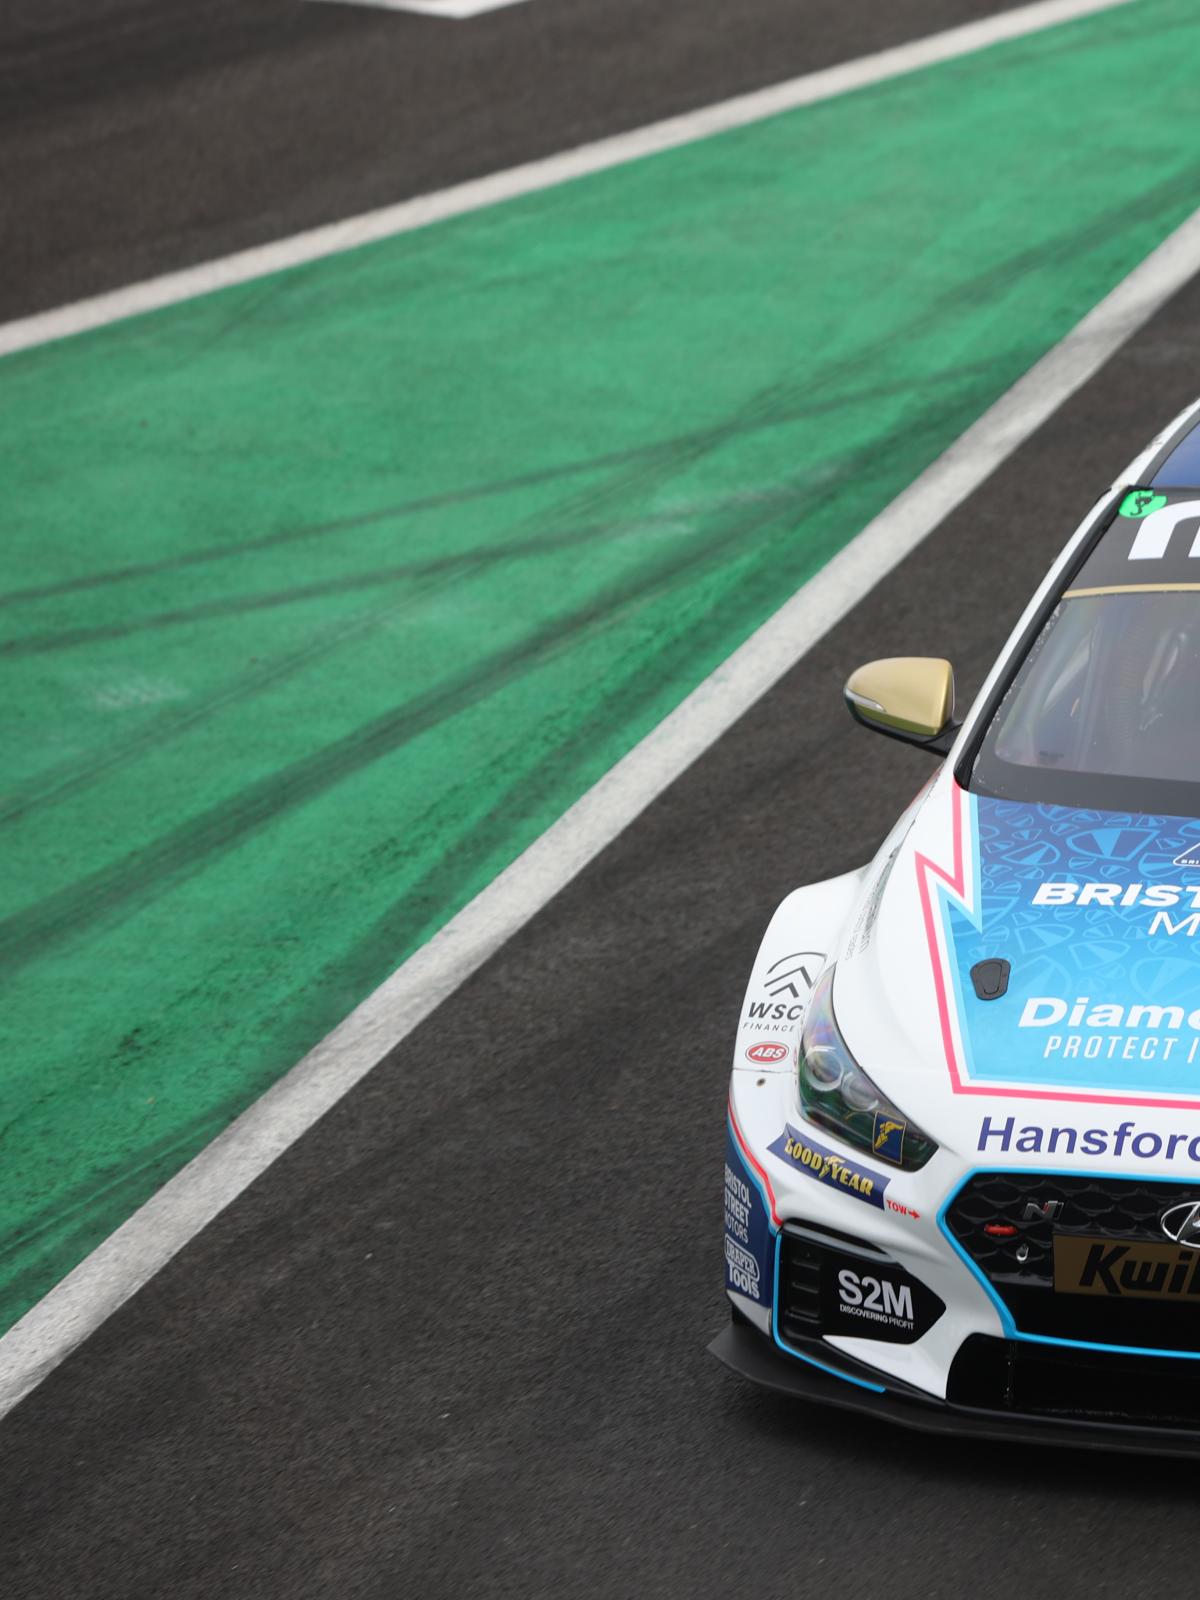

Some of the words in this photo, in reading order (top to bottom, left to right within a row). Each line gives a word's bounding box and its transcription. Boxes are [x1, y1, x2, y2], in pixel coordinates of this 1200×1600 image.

[749, 1003, 803, 1021] WSC
[743, 1022, 796, 1032] FINANCE
[751, 1044, 785, 1058] ABS
[1044, 1035, 1178, 1060] PROTECT
[887, 1199, 908, 1216] TOW
[838, 1269, 914, 1320] S2M
[840, 1304, 889, 1324] DISCOVERING
[889, 1317, 915, 1331] PROFIT
